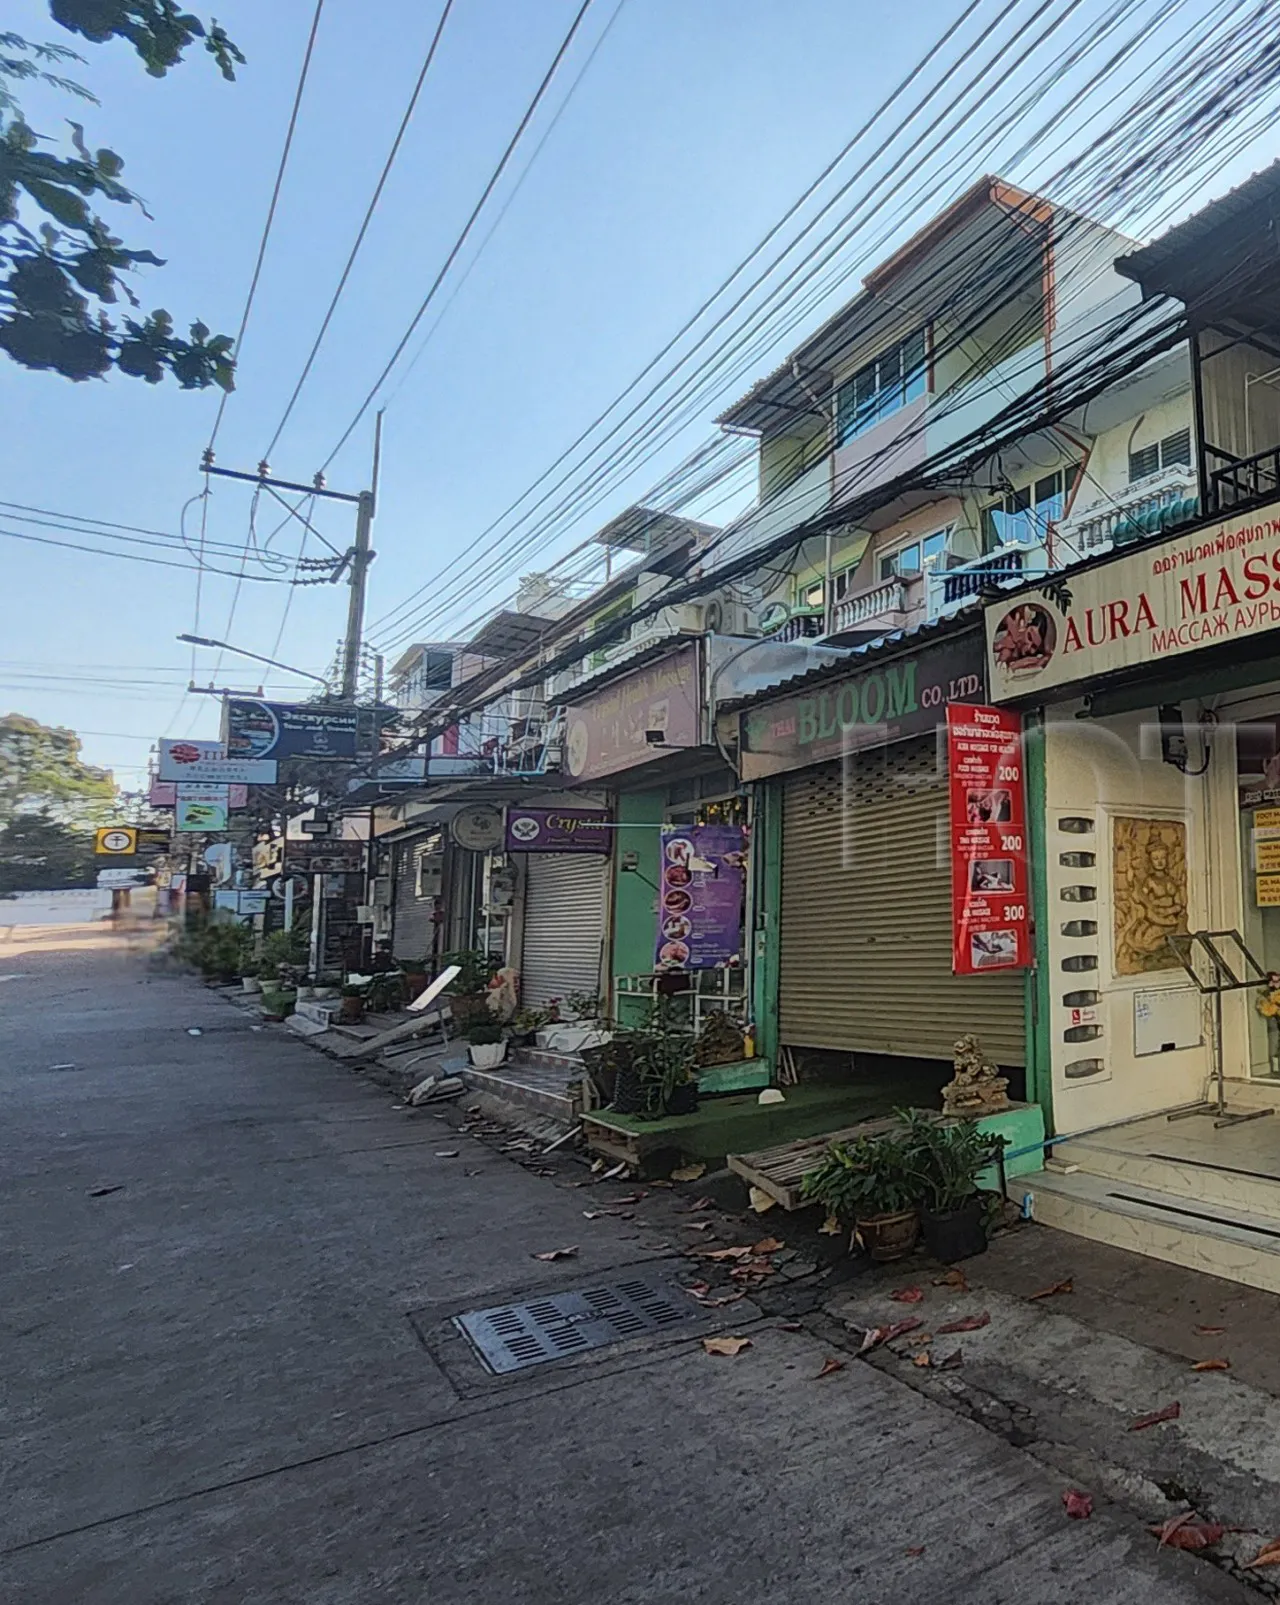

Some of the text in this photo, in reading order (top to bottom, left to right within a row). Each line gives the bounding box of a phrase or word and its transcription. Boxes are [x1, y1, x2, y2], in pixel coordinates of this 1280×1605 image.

[1062, 594, 1157, 654] AURA
[1150, 610, 1233, 654] МАССАЖ
[797, 660, 919, 745] BLOOM
[281, 711, 356, 725] Экскурсии
[998, 766, 1019, 781] 200
[1001, 835, 1022, 851] 200
[1003, 905, 1025, 922] 300
